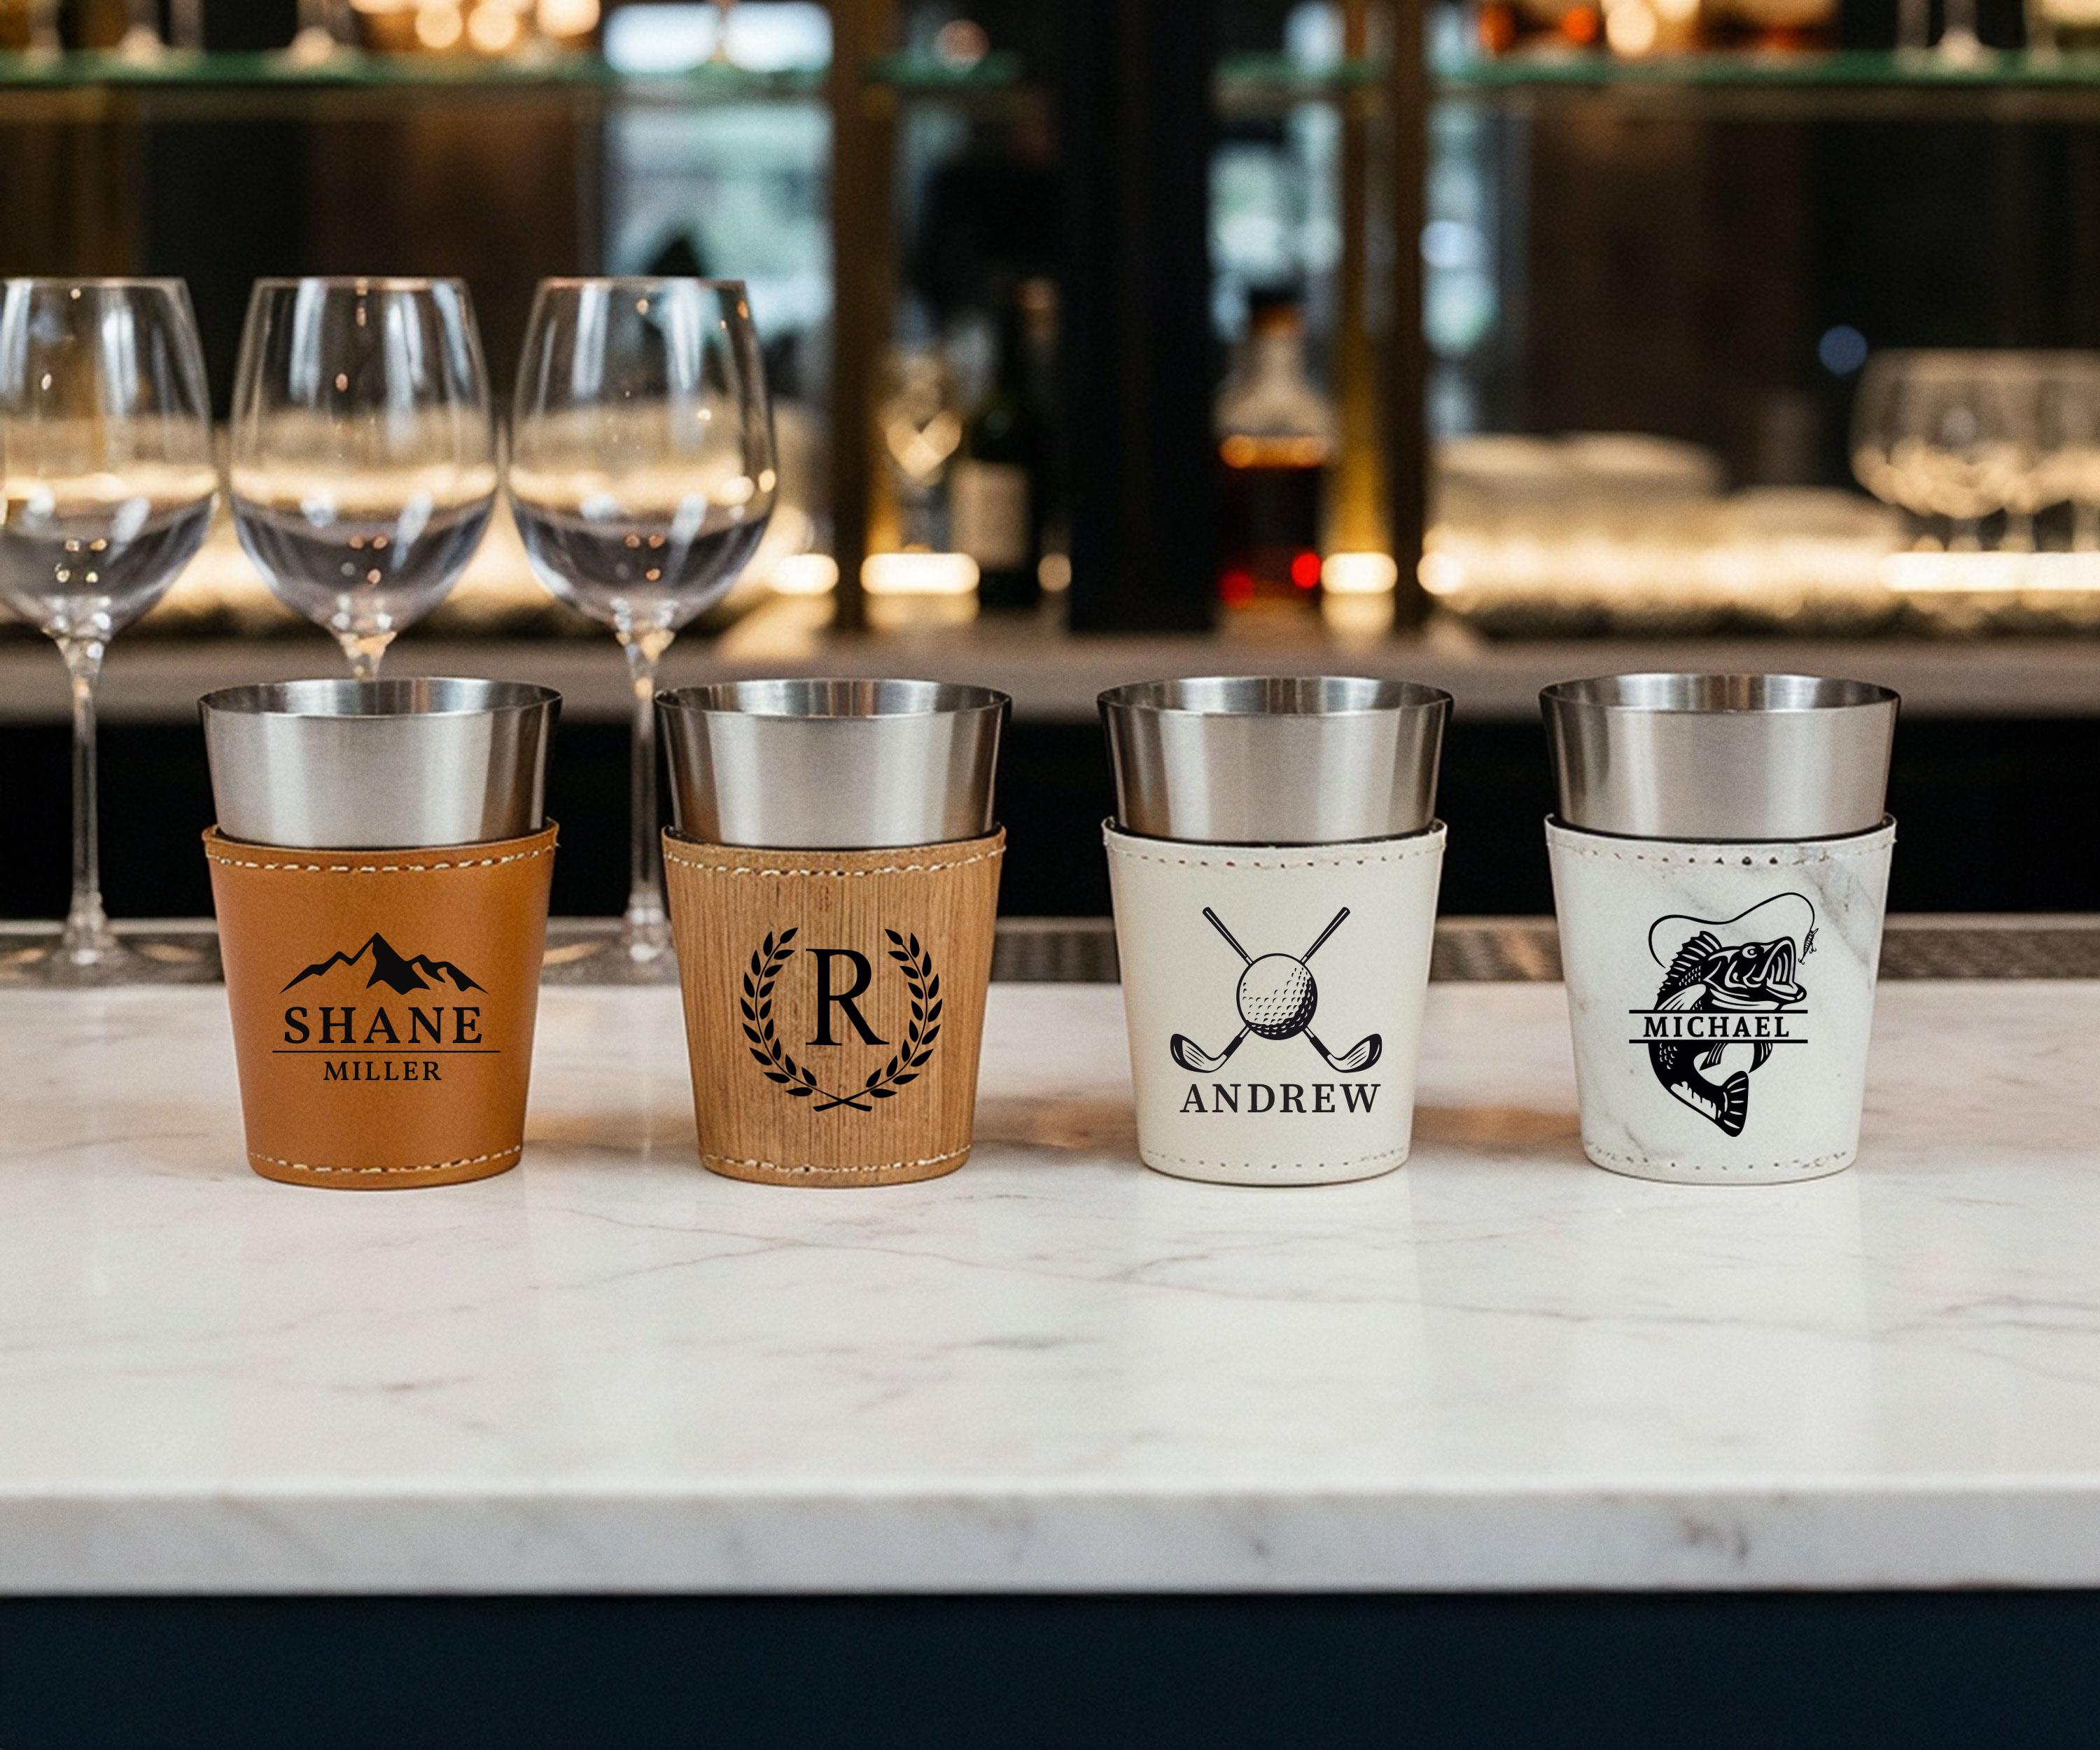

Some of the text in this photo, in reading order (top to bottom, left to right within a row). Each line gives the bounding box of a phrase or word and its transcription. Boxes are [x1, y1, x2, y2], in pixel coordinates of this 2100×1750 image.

[806, 948, 890, 1046] R
[284, 1006, 483, 1044] SHANE
[1643, 1016, 1790, 1037] MICHAEL
[323, 1060, 442, 1082] MILLER
[1180, 1084, 1381, 1113] ANDREW
